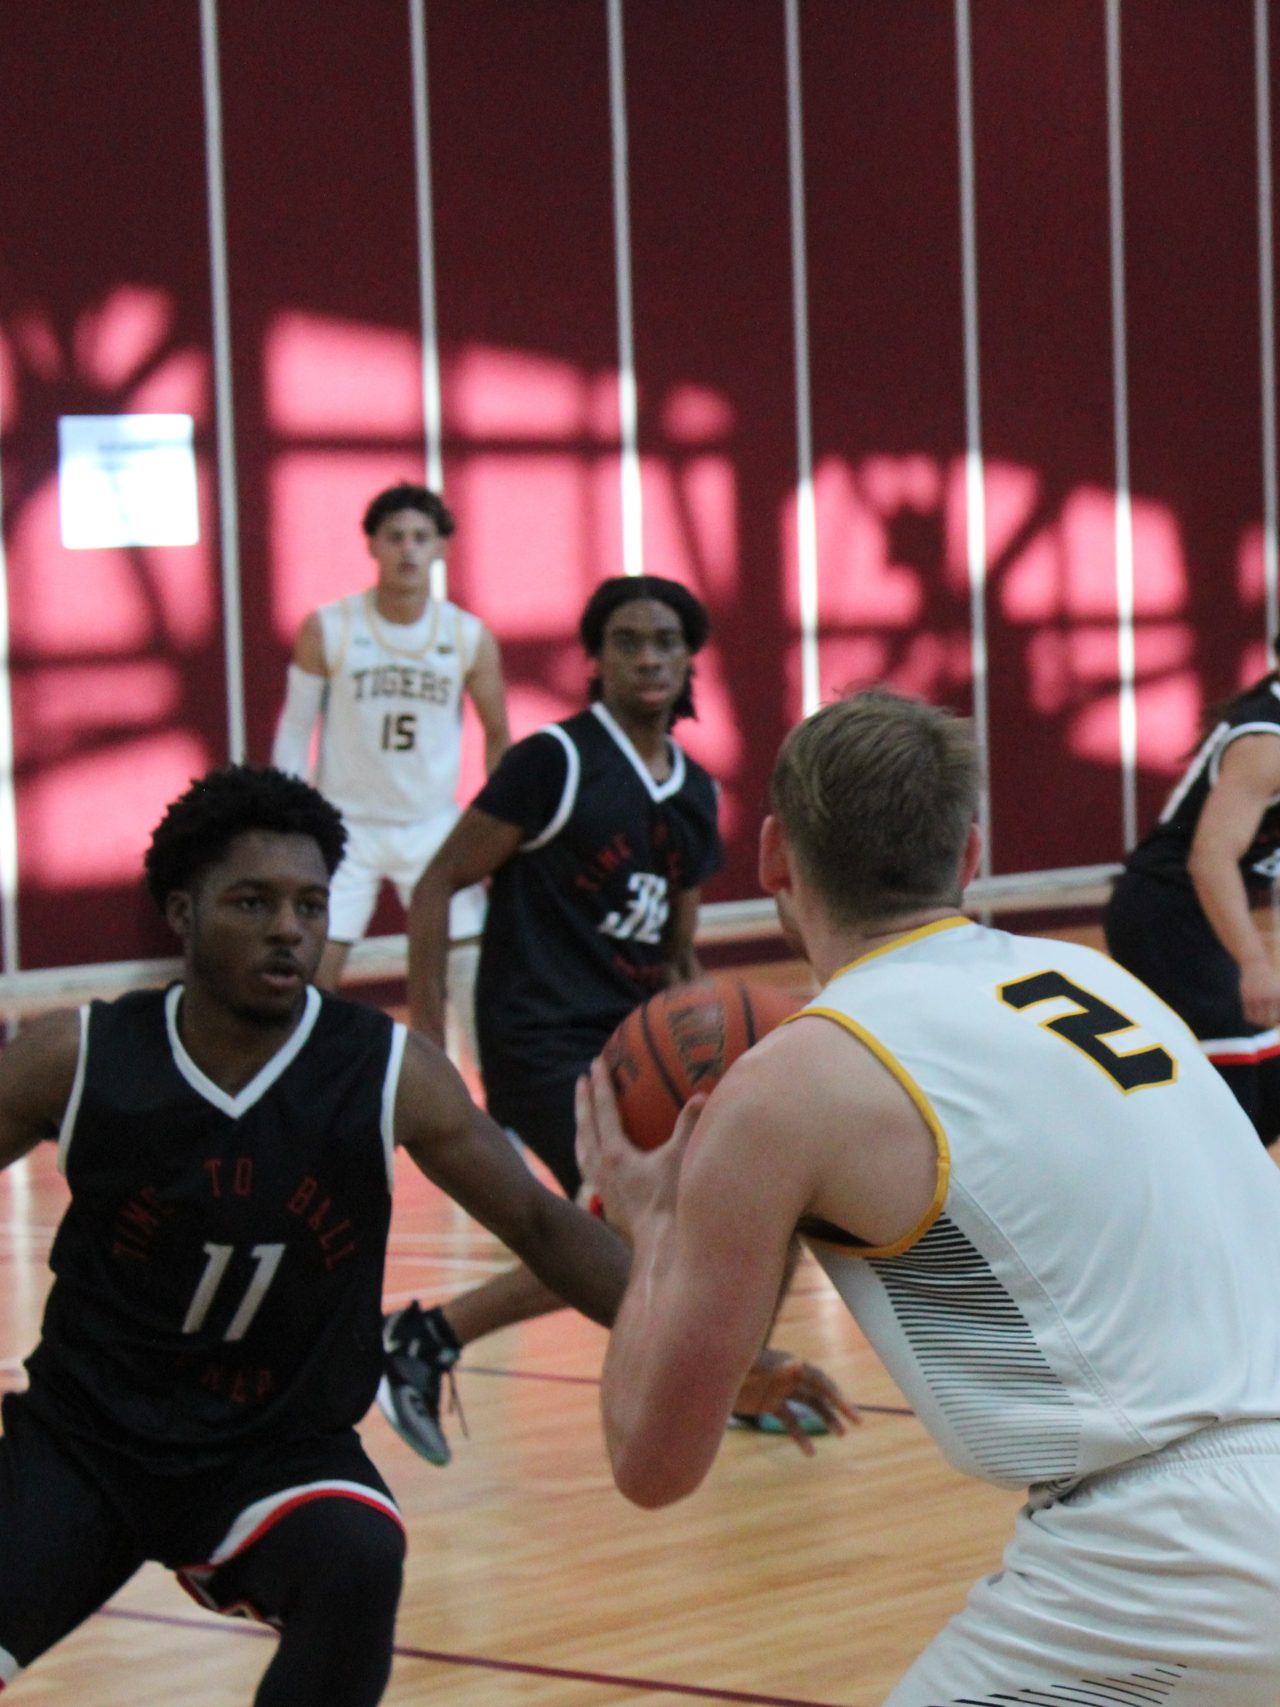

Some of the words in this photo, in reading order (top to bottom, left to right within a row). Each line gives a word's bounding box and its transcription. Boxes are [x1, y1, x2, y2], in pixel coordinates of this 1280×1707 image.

[352, 664, 453, 706] TIGERS
[381, 714, 417, 751] 15
[597, 871, 670, 945] 32
[996, 970, 1178, 1096] 2
[203, 1156, 255, 1199] TO
[287, 1174, 358, 1271] BALL
[180, 1240, 287, 1342] 11
